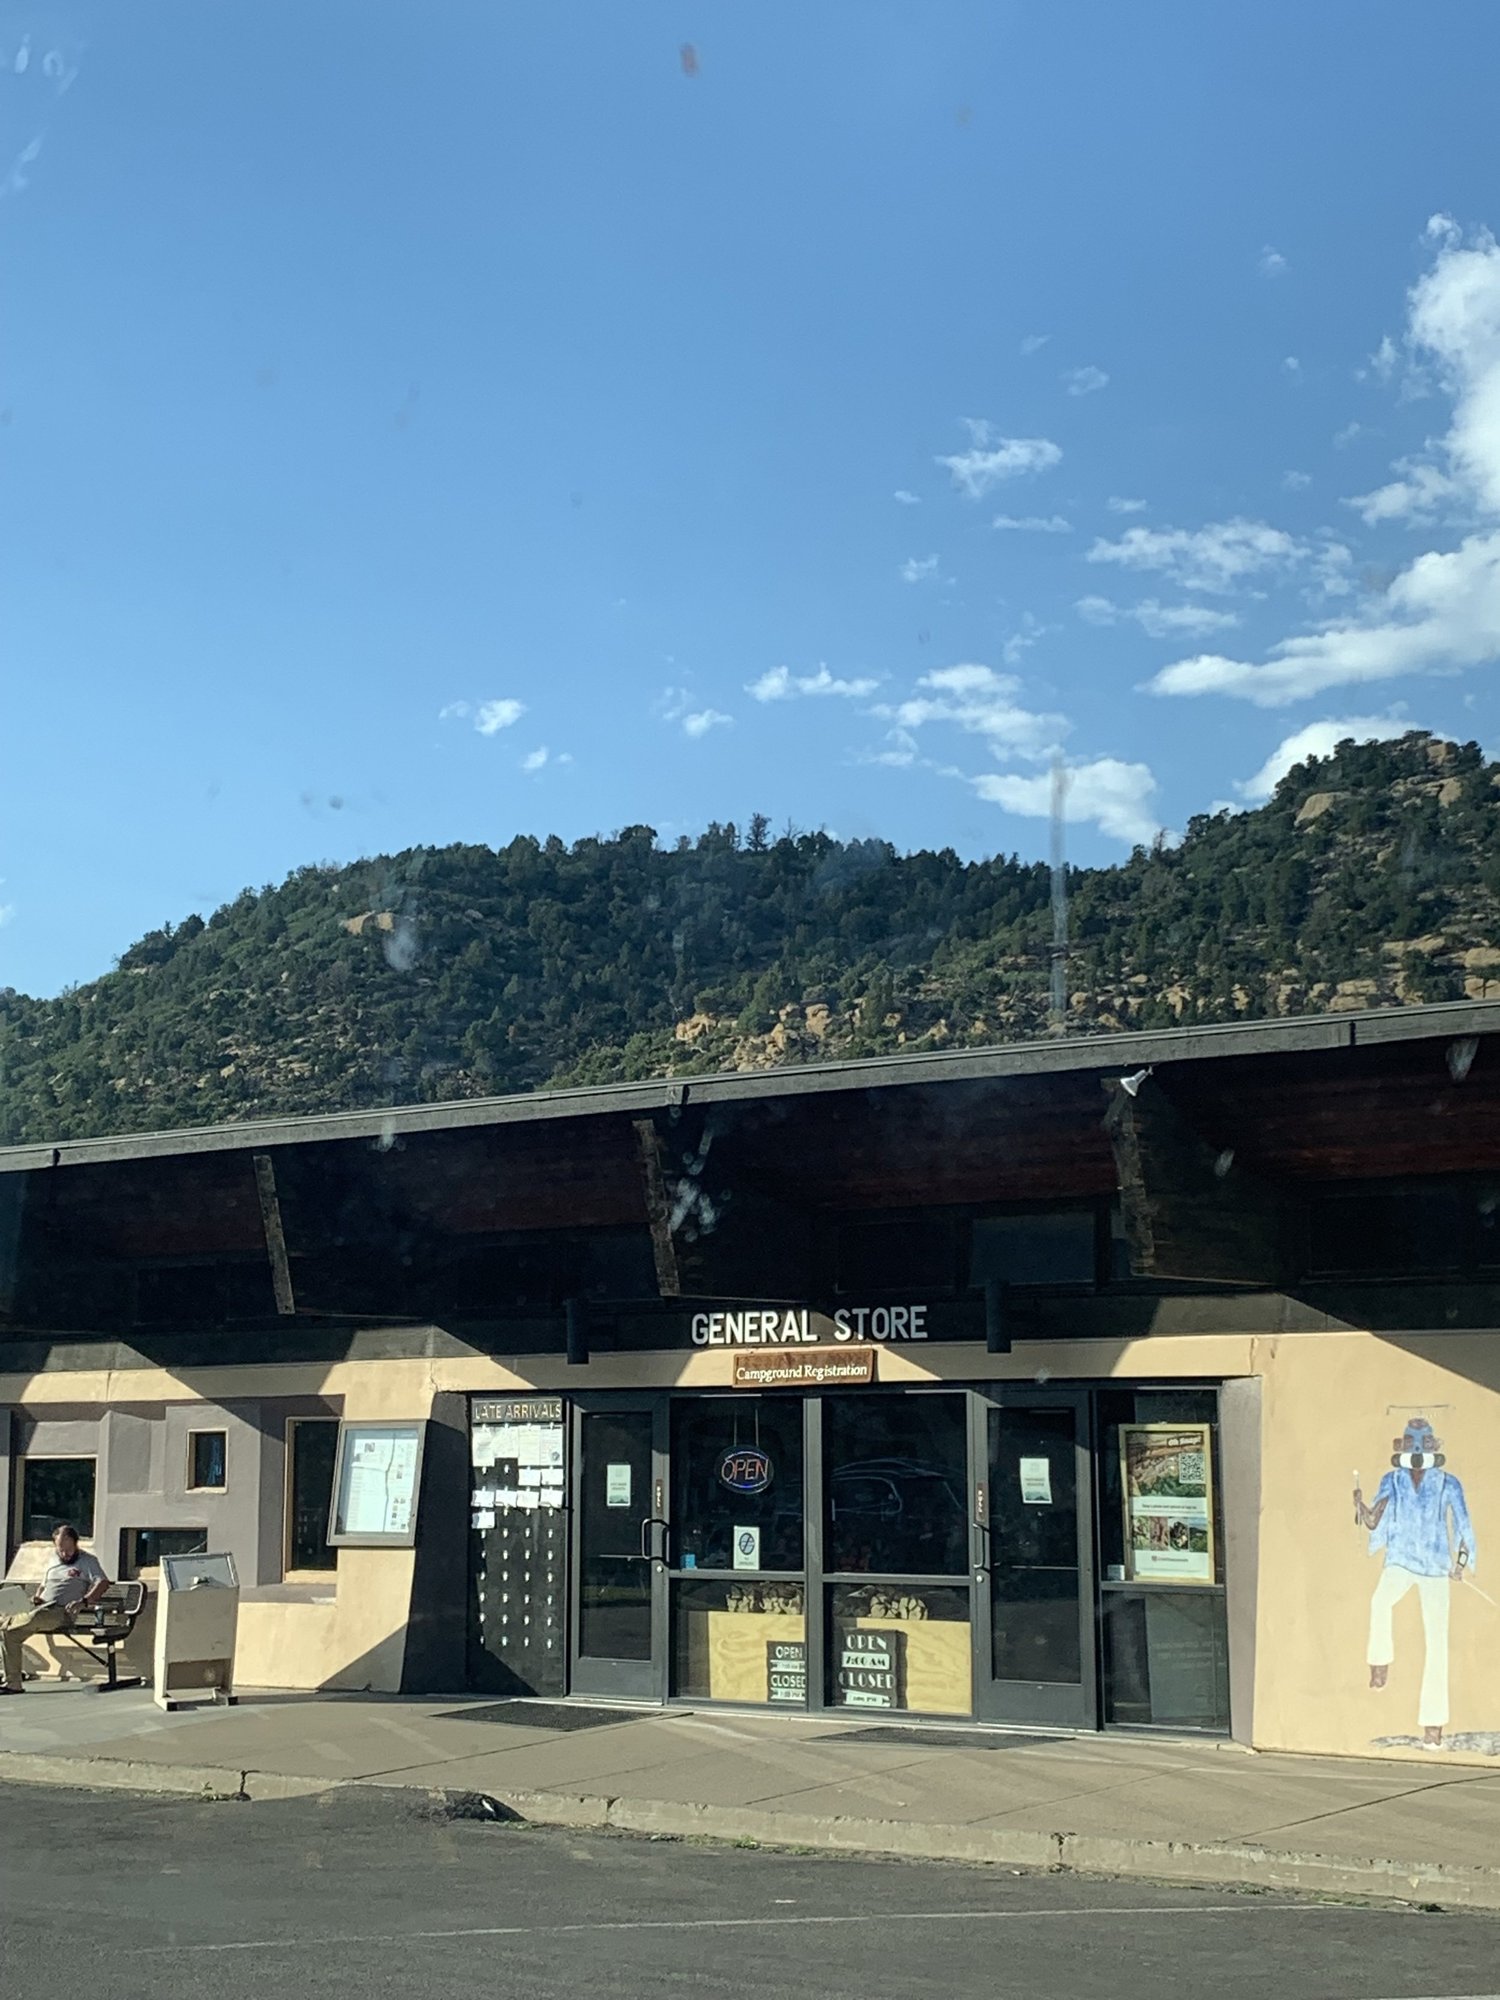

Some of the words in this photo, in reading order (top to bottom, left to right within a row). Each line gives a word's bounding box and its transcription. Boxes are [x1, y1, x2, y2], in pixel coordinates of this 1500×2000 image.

[691, 1309, 818, 1345] GENERAL
[834, 1305, 928, 1341] STORE
[736, 1365, 802, 1382] Campground
[804, 1363, 867, 1380] Registration
[475, 1404, 502, 1420] LATE
[505, 1403, 561, 1419] ARRIVALS
[721, 1458, 769, 1482] OPEN
[846, 1634, 887, 1650] OPEN
[775, 1646, 803, 1659] OPEN
[838, 1671, 895, 1689] CLOSED
